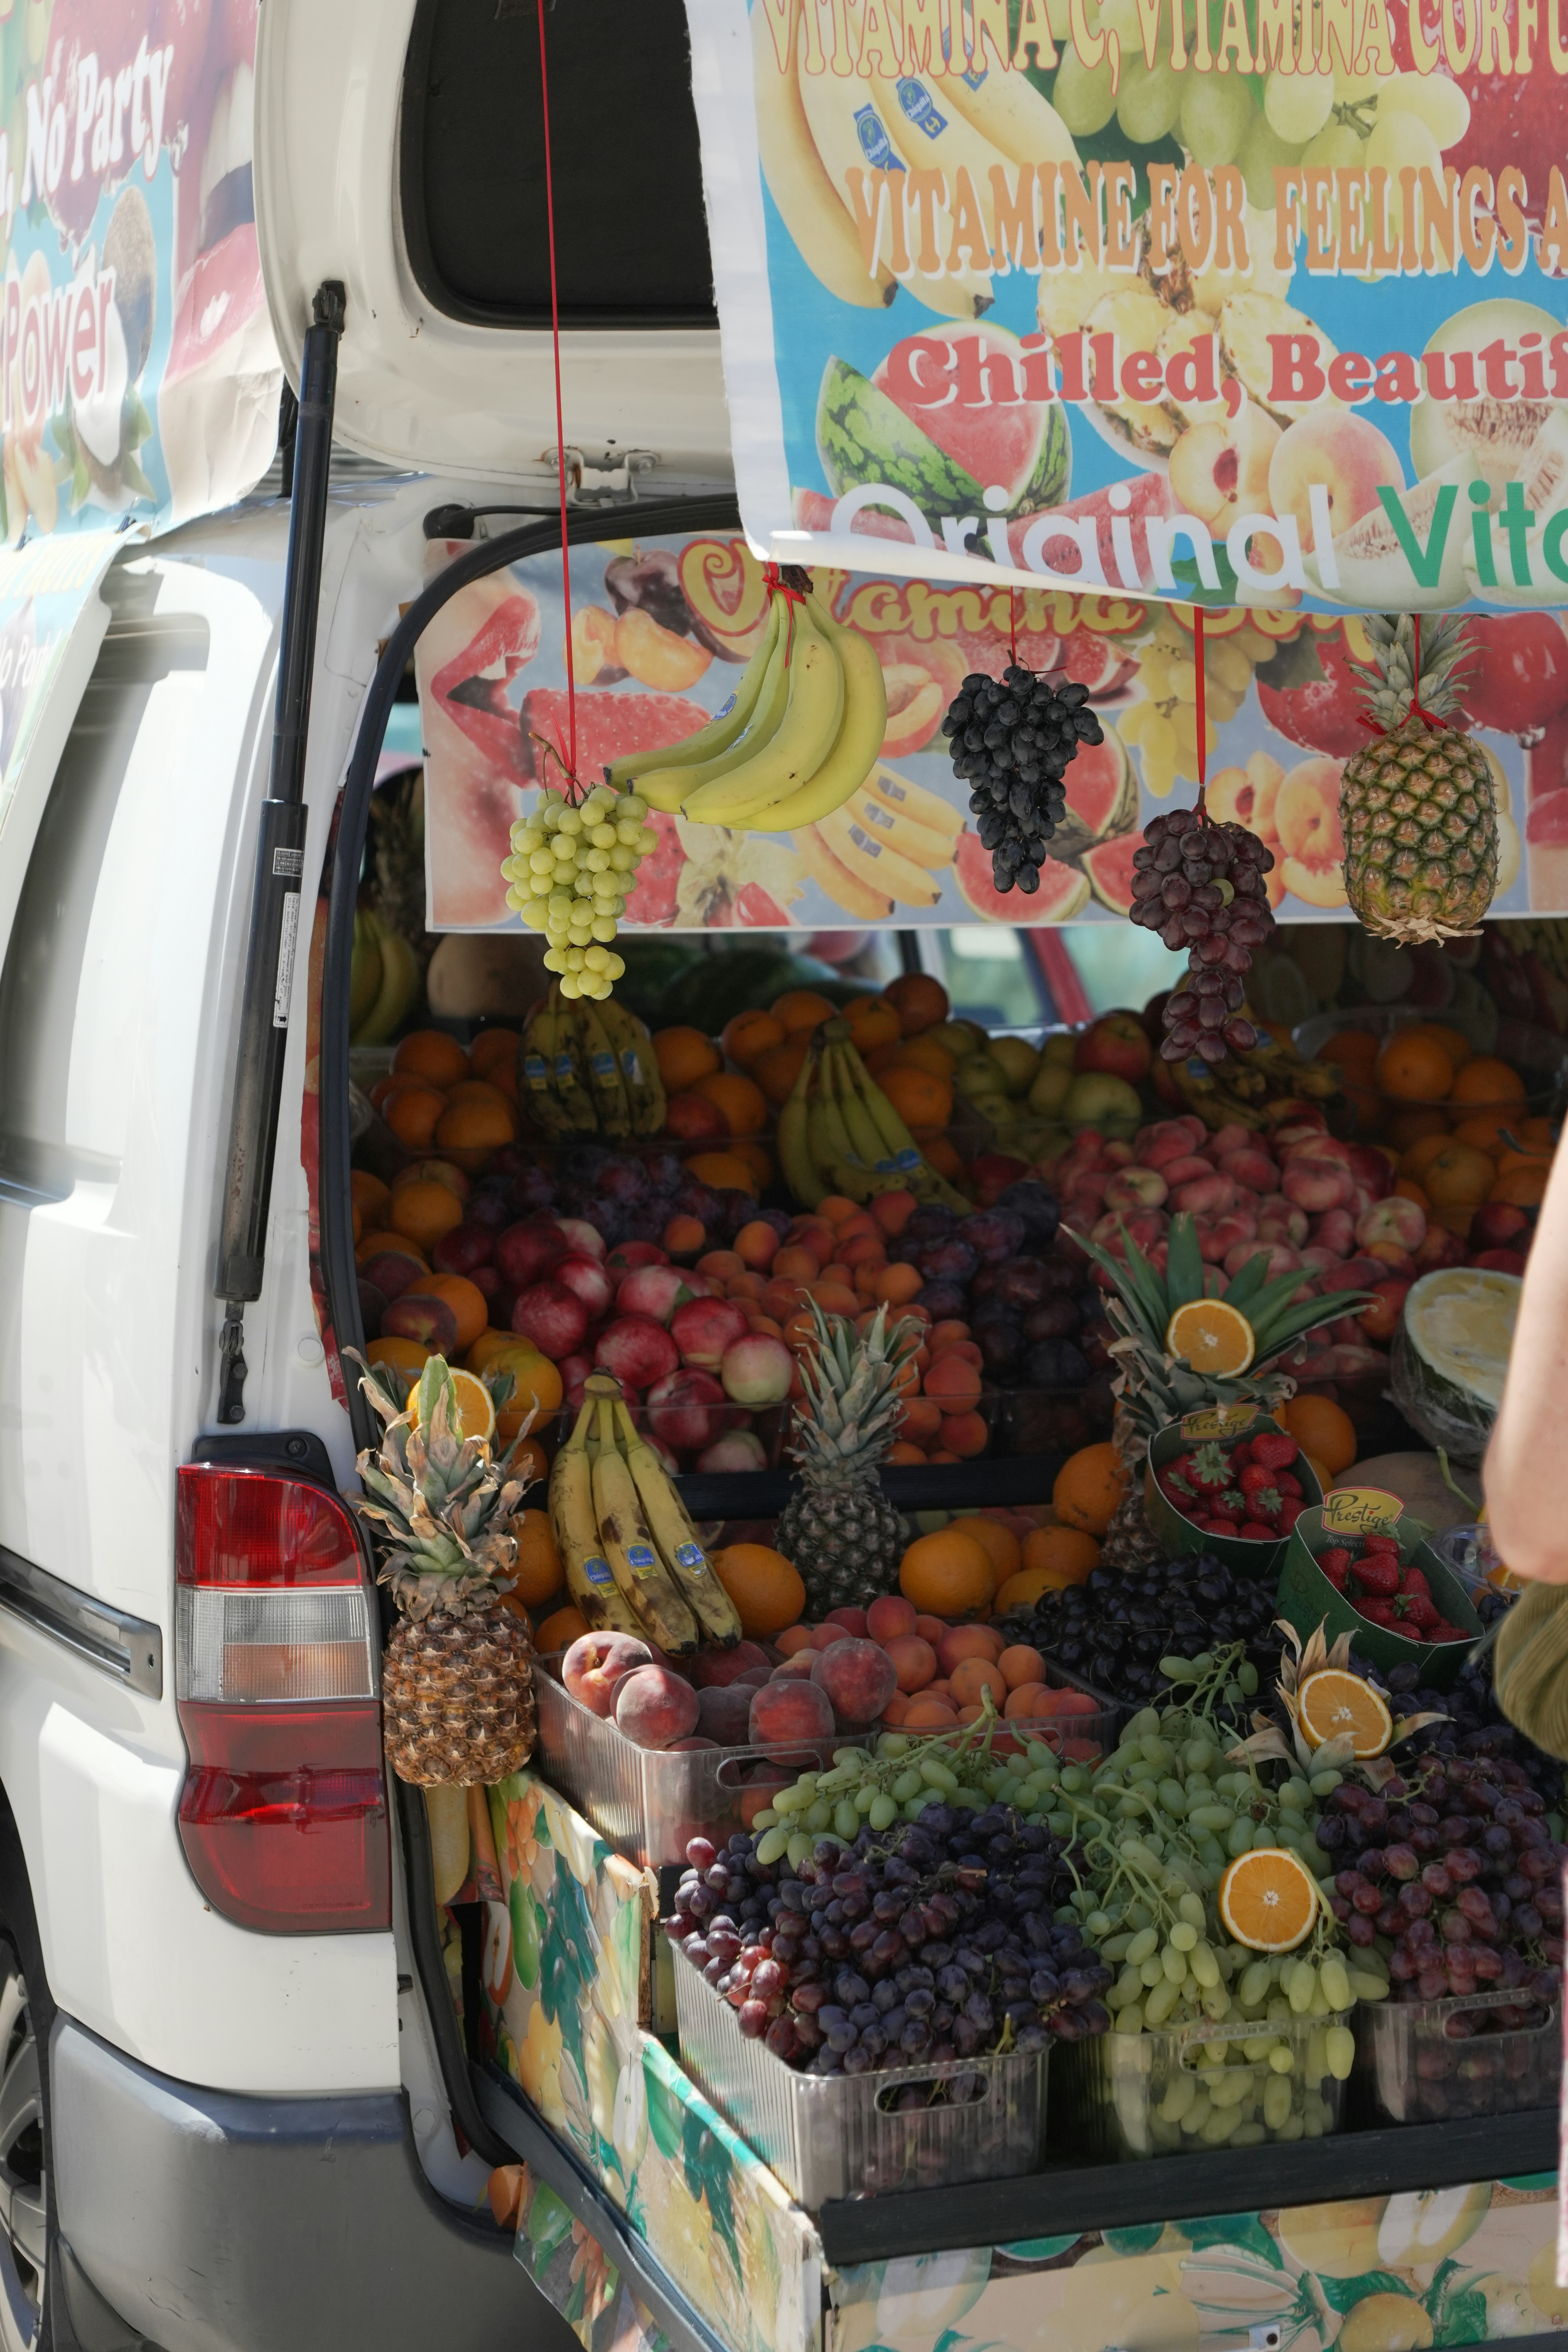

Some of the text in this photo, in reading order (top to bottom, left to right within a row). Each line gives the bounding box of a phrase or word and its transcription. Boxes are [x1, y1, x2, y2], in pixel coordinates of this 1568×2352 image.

[764, 0, 1059, 78] VITAMINA
[1137, 0, 1396, 76] VITAMINA
[20, 74, 66, 205] No
[71, 32, 175, 182] Party
[844, 160, 1137, 277] VITAMINE
[1146, 162, 1253, 277] FOR
[1272, 165, 1528, 276] FEELINGS
[3, 270, 115, 430] Power
[886, 331, 1247, 419] Chilled,
[1326, 1535, 1340, 1547] Top
